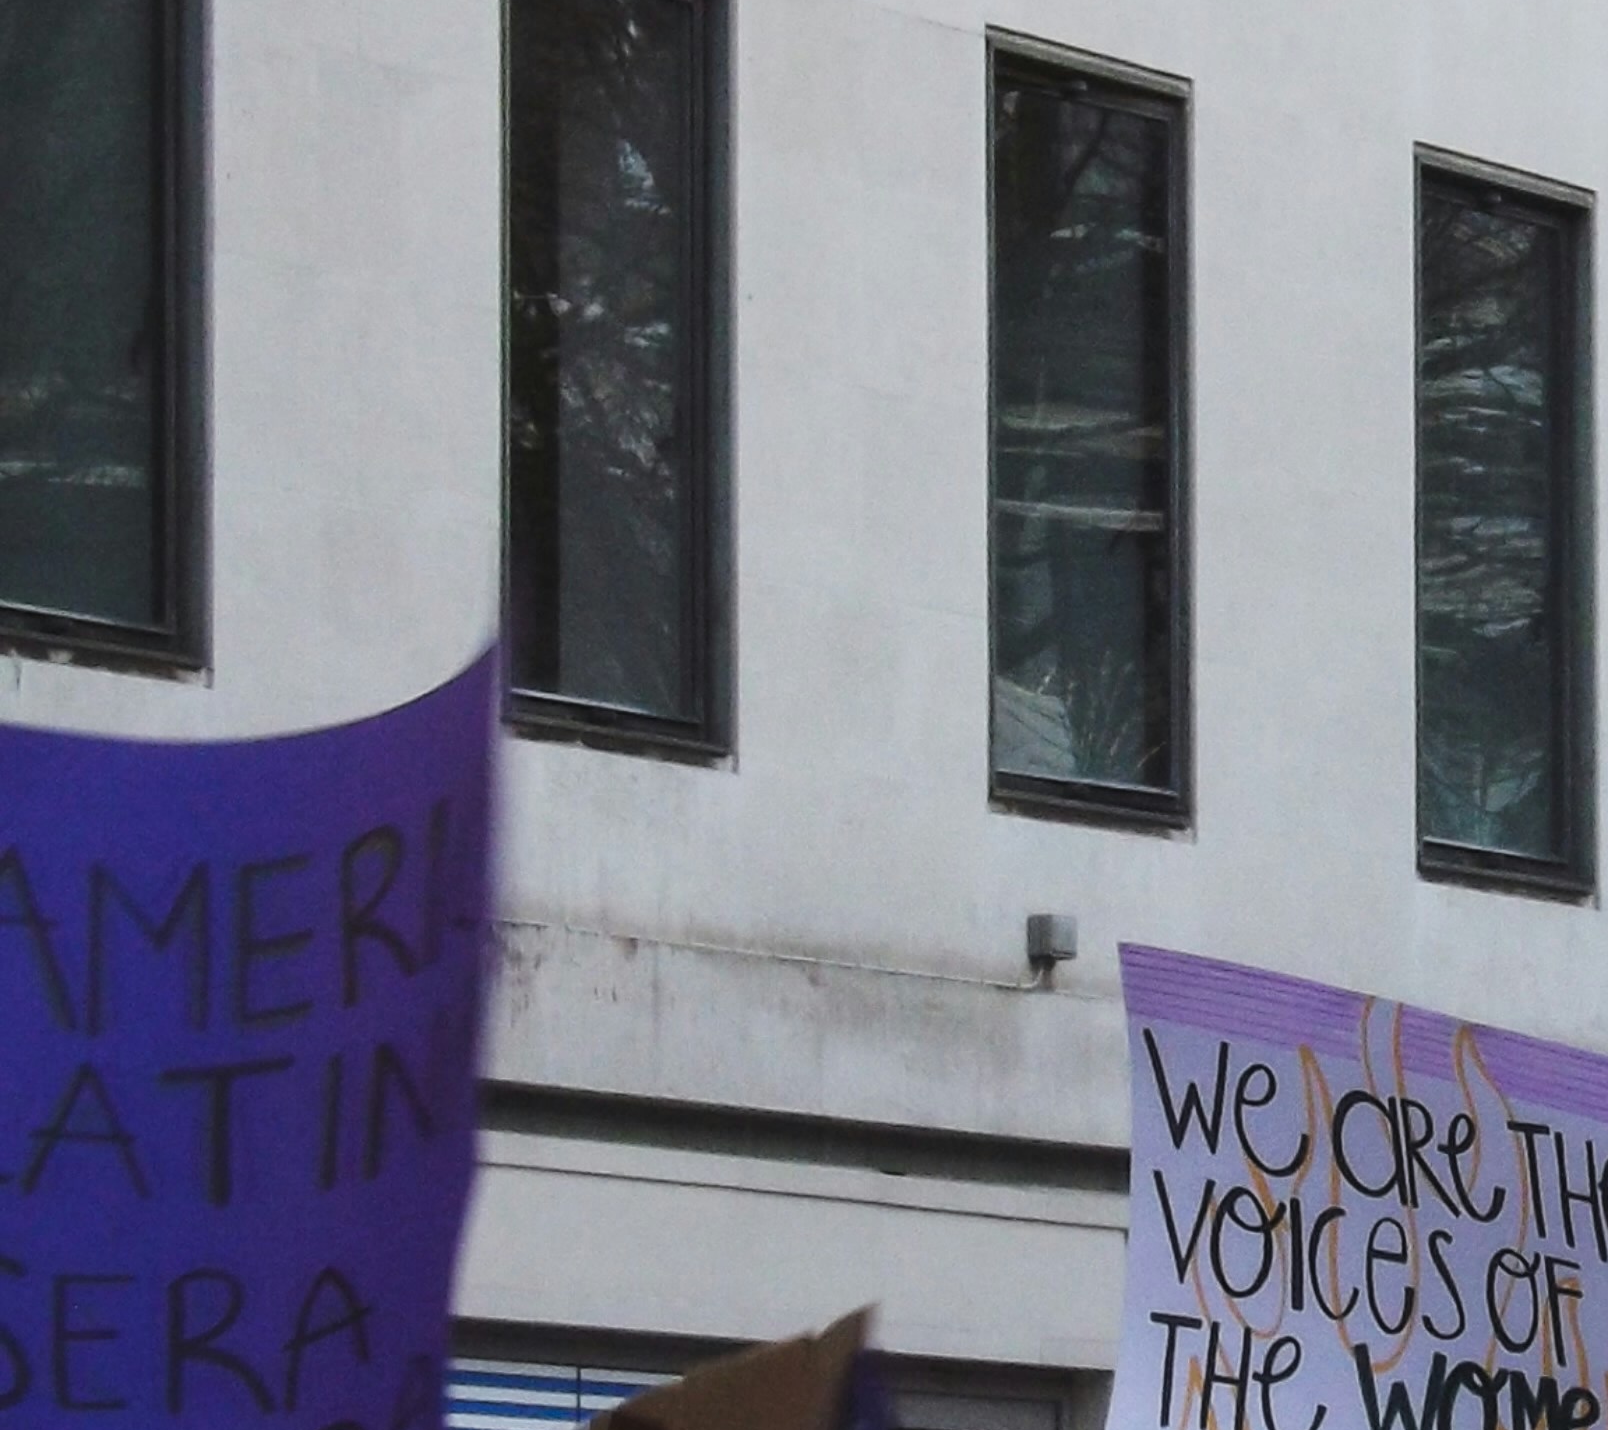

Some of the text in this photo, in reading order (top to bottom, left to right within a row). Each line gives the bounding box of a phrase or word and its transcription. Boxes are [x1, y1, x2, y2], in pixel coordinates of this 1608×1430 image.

[0, 799, 487, 1038] AMERI
[0, 1041, 434, 1208] ATIN
[1143, 1028, 1309, 1177] We
